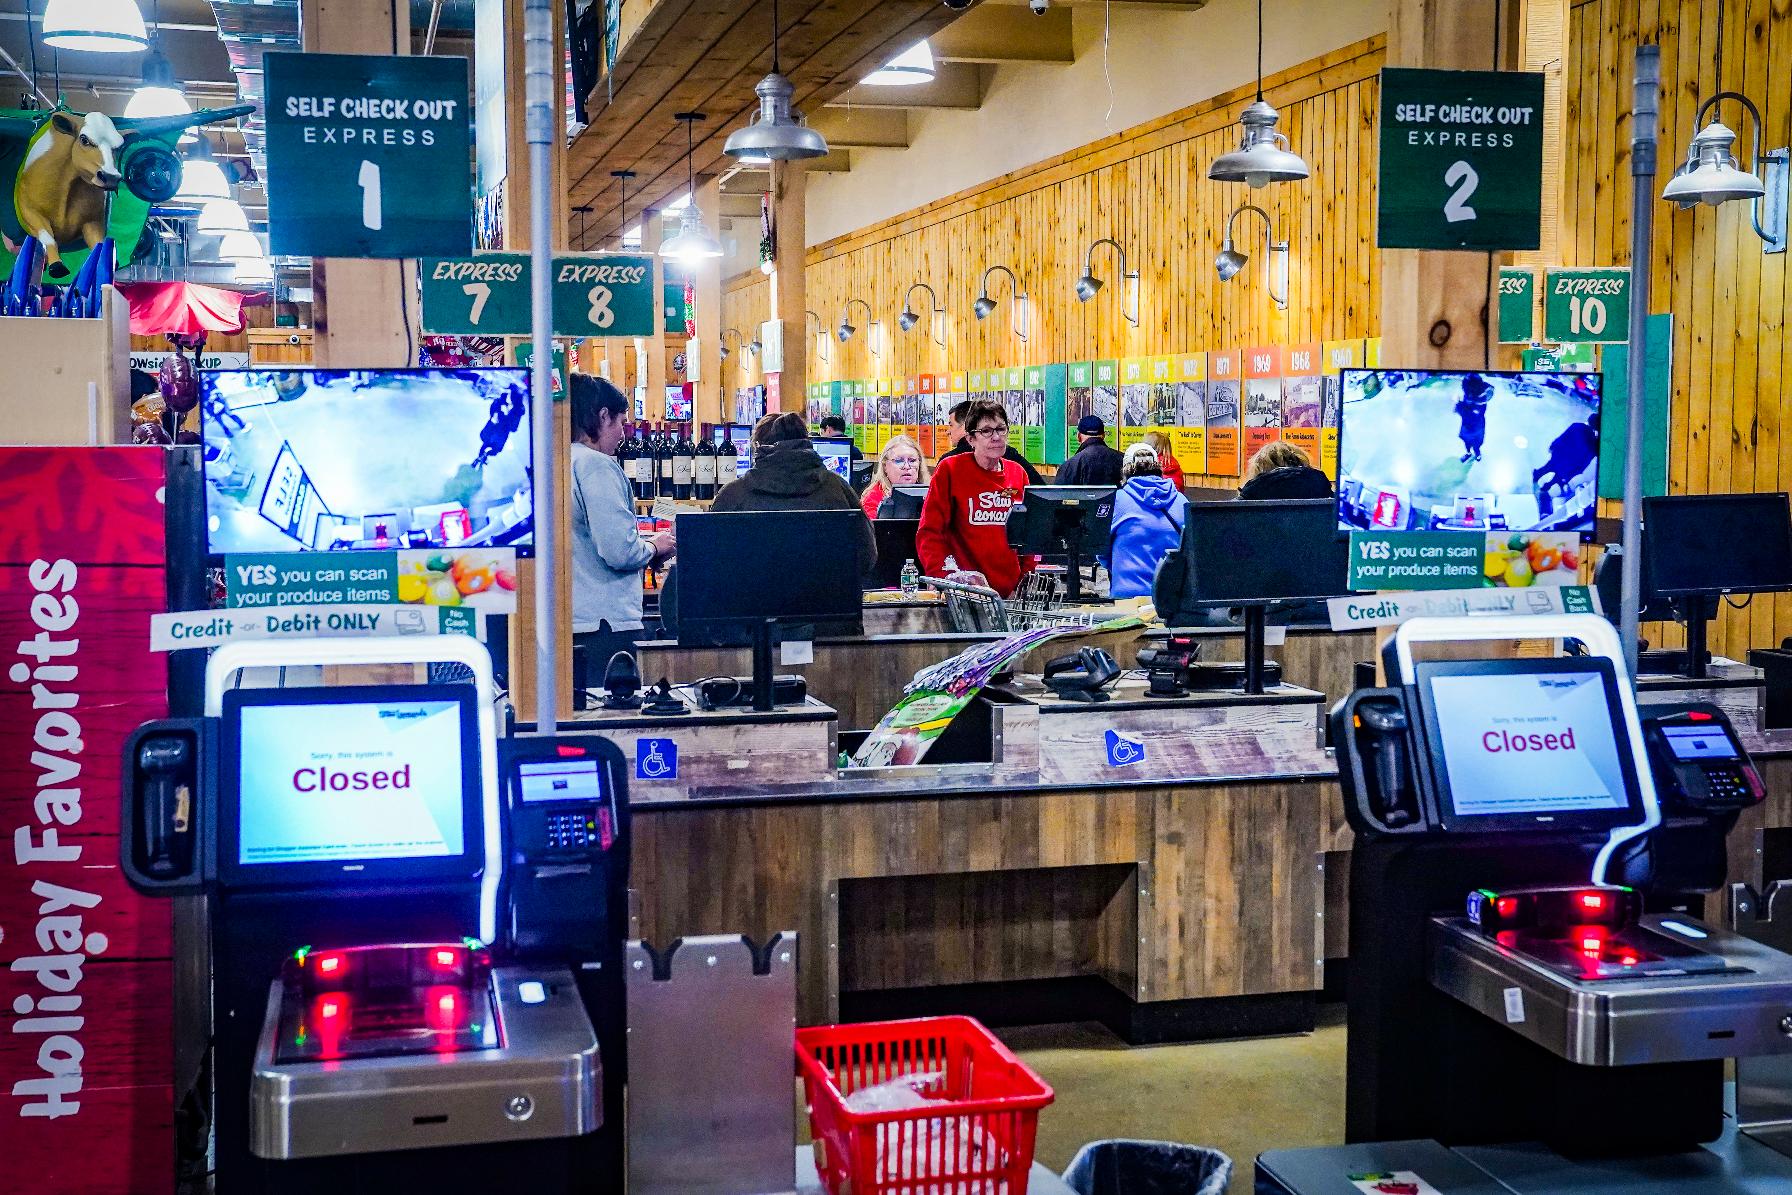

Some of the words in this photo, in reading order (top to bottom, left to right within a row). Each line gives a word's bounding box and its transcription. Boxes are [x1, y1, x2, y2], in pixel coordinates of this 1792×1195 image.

[286, 96, 335, 118] SELF
[340, 97, 409, 120] CHECK
[412, 99, 457, 121] OUT
[1395, 103, 1436, 123] SELF
[1438, 104, 1495, 125] CHECK
[1497, 107, 1534, 125] OUT
[303, 126, 435, 146] EXPRESS
[1408, 130, 1514, 148] EXPRESS
[358, 159, 382, 231] 1
[1443, 160, 1479, 223] 2
[432, 261, 523, 282] EXPRESS
[557, 264, 646, 284] EXPRESS
[1554, 278, 1625, 295] EXPRESS
[462, 282, 492, 326] 7
[587, 285, 615, 329] 8
[1569, 295, 1607, 335] 10
[1253, 353, 1272, 373] 1969
[1291, 351, 1311, 371] 1968
[1358, 541, 1390, 560] YES
[1393, 545, 1418, 561] you
[1419, 546, 1443, 558] can
[1446, 545, 1477, 558] scan
[236, 565, 278, 587] YES
[281, 568, 312, 586] you
[314, 569, 345, 583] can
[349, 566, 388, 581] scan
[1356, 564, 1385, 579] your
[1388, 563, 1441, 579] produce
[1443, 562, 1477, 576] items
[235, 590, 274, 607] your
[276, 589, 343, 606] produce
[347, 586, 391, 602] items
[1347, 601, 1399, 620] Credit
[171, 618, 233, 640] Credit
[266, 614, 321, 633] Debit
[327, 613, 381, 632] ONLY
[9, 558, 84, 865] Favorites
[1482, 727, 1576, 753] Closed
[293, 764, 410, 792] Closed
[10, 879, 103, 1120] Holiday
